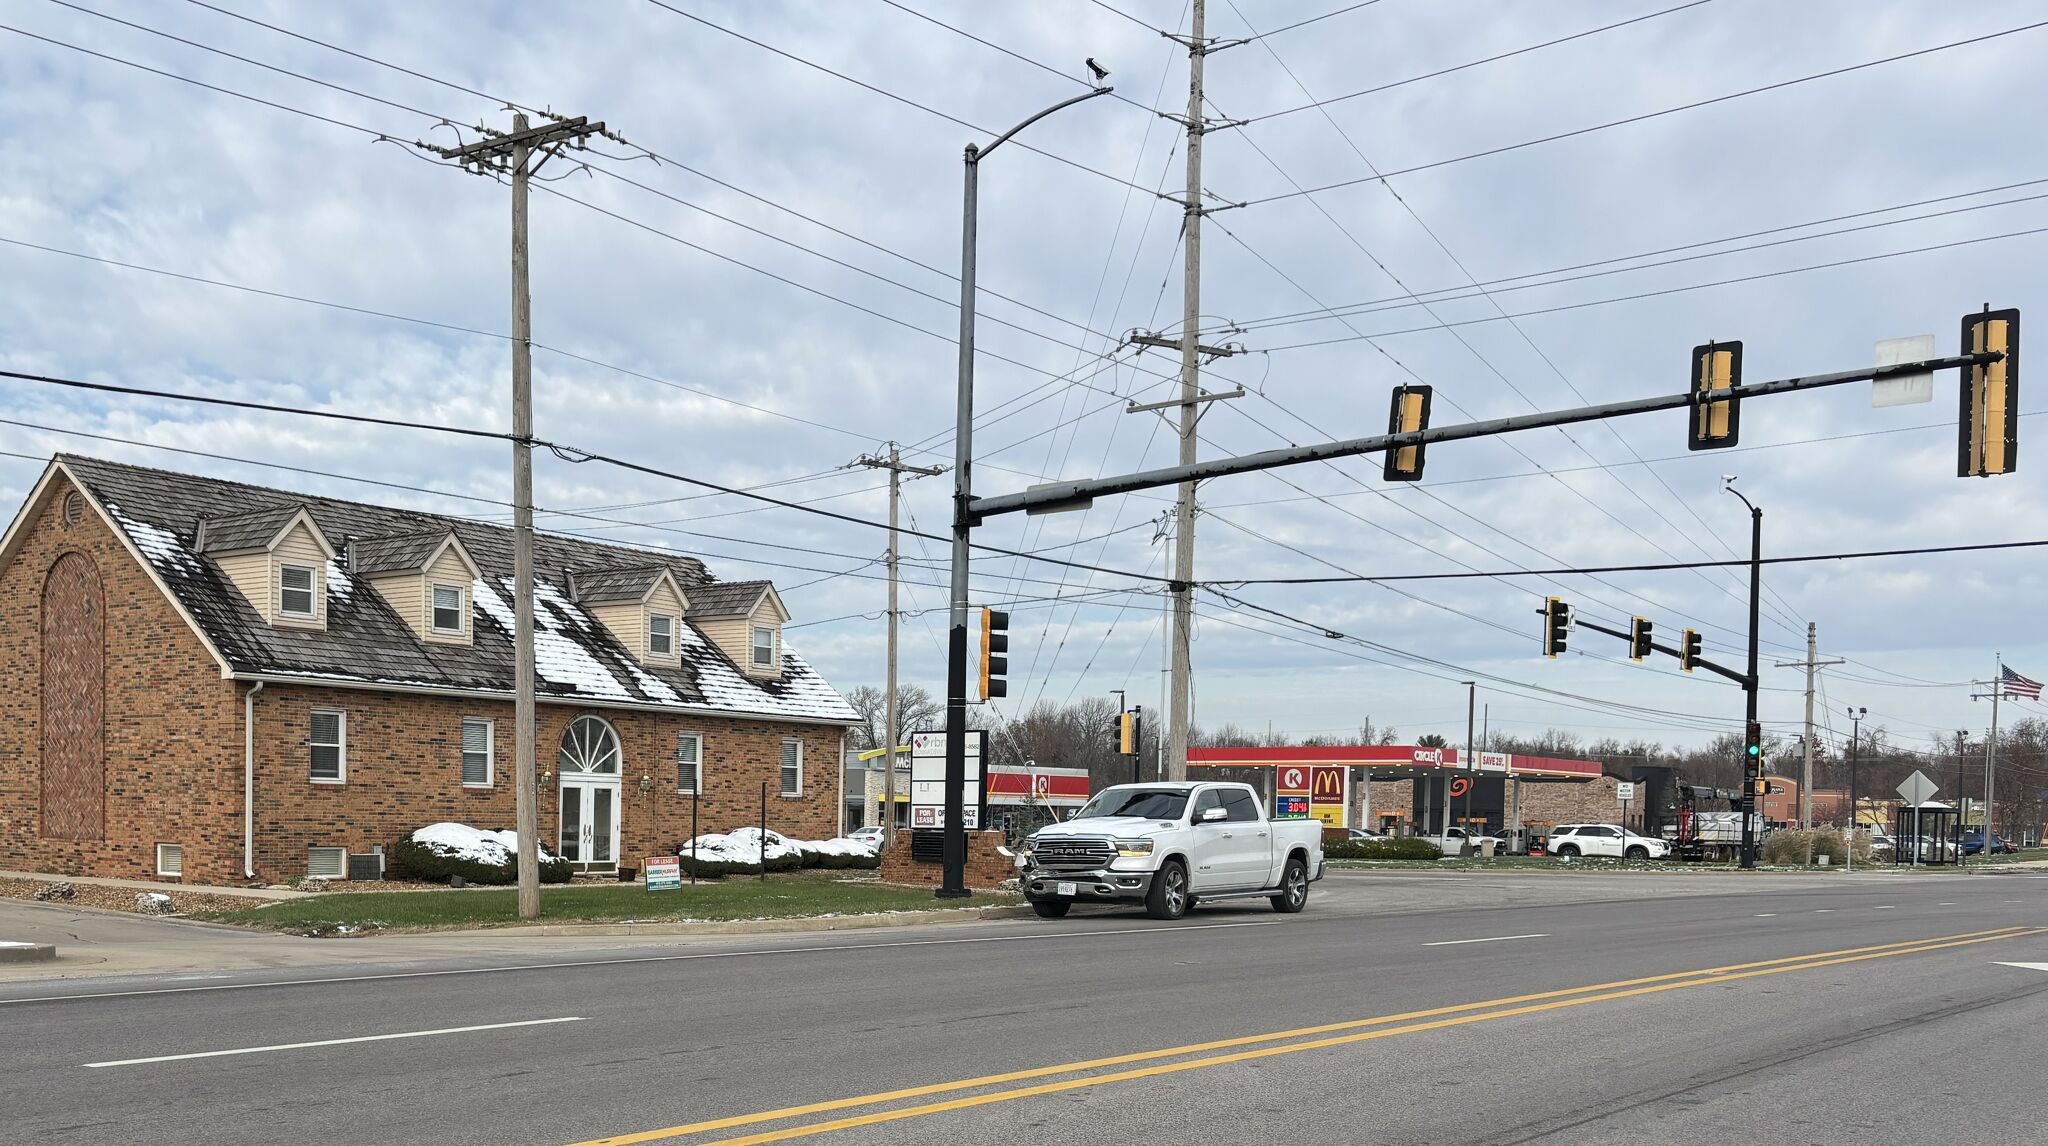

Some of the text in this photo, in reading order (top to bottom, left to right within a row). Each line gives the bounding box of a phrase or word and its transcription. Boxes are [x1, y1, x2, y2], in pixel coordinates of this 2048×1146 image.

[896, 757, 911, 768] Mc
[1414, 750, 1435, 762] CIRCLE
[1435, 749, 1443, 766] K
[1482, 756, 1496, 766] SAVE
